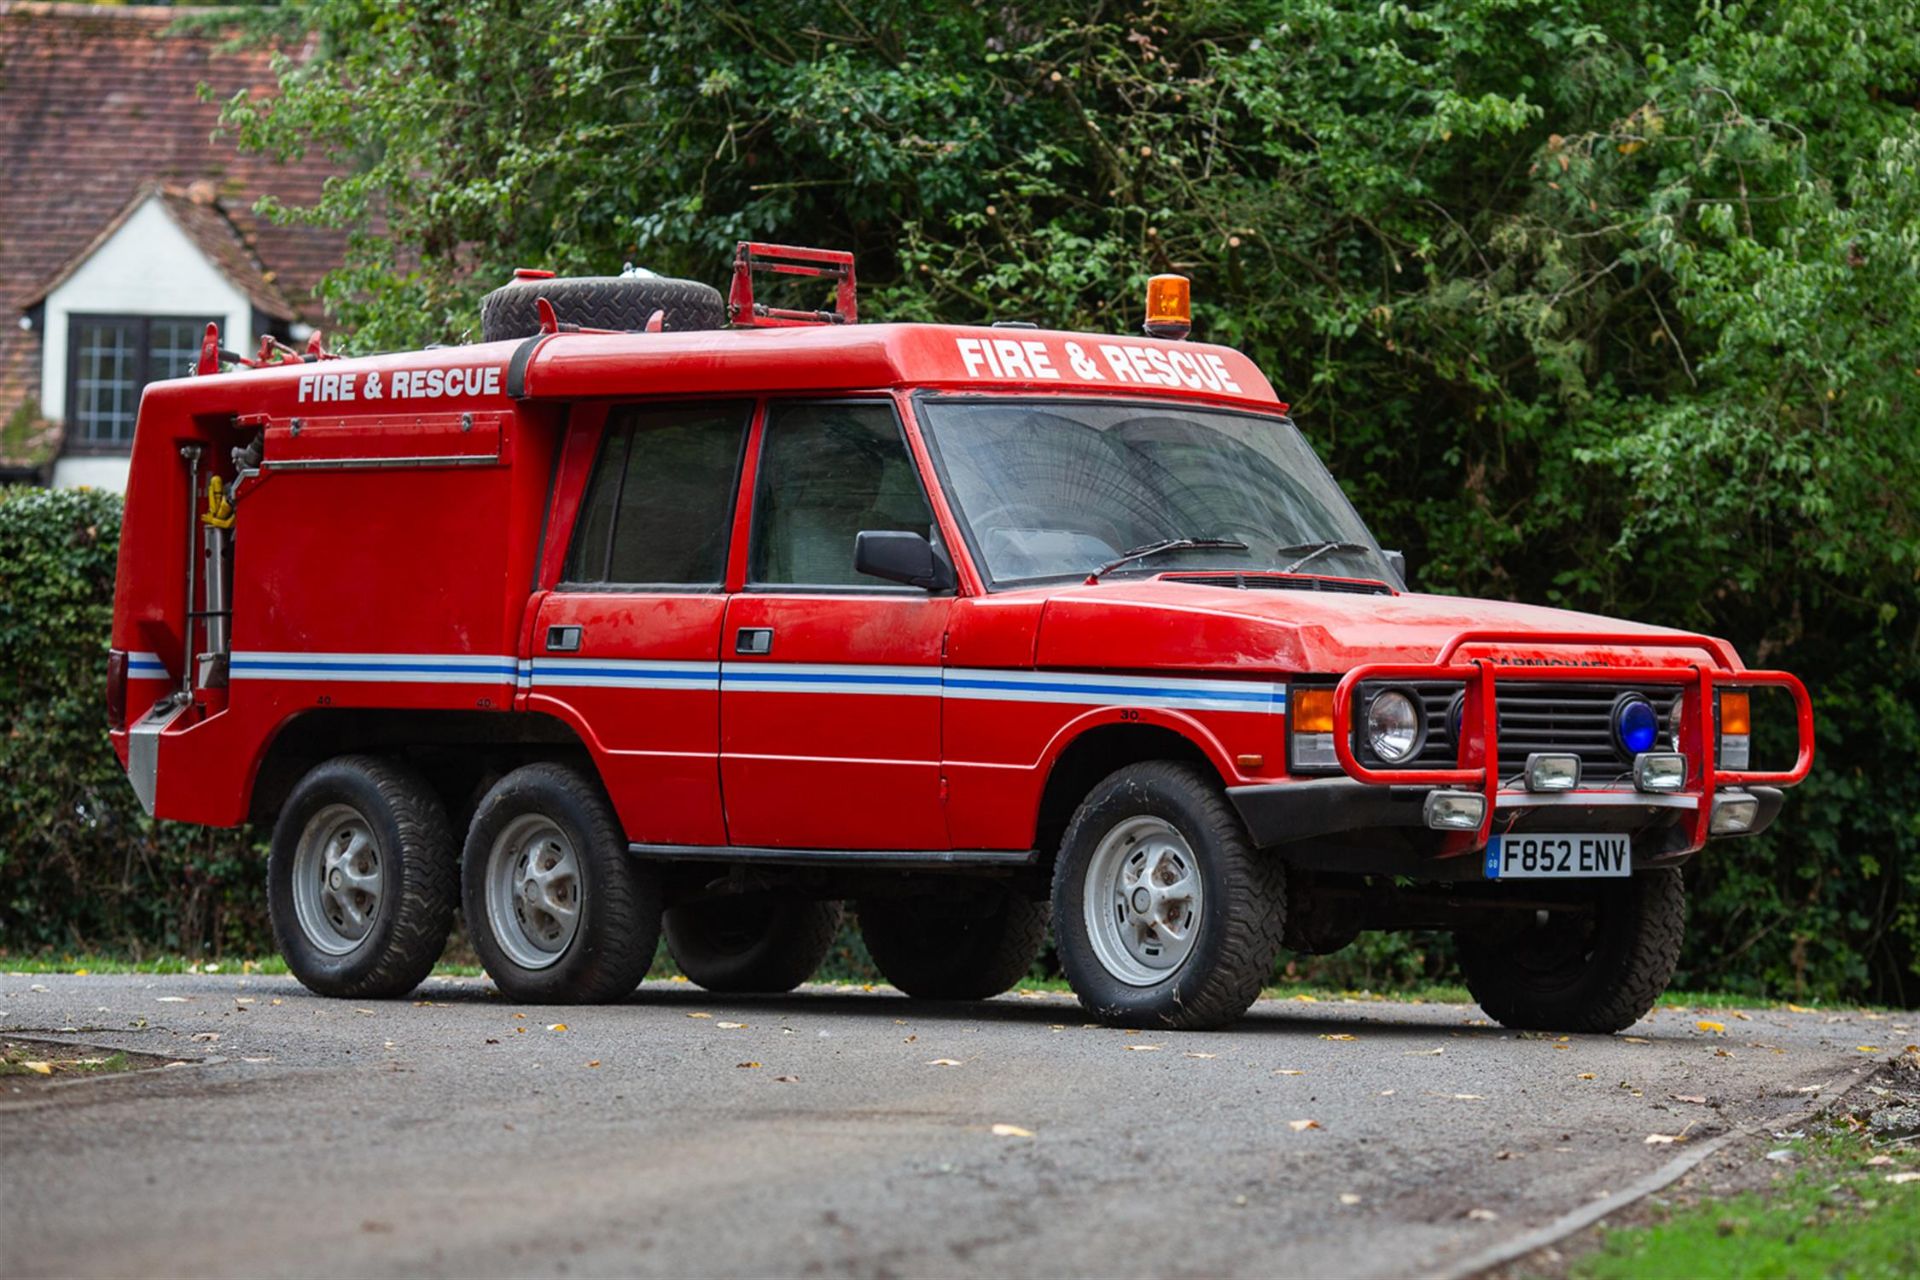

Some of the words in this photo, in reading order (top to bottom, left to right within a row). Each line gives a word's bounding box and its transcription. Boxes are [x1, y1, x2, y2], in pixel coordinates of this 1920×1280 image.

[955, 337, 1060, 380] FIRE
[1064, 340, 1105, 381] &
[1099, 344, 1243, 394] RESCUE
[298, 373, 357, 403] FIRE
[363, 371, 383, 400] &
[391, 367, 501, 399] RESCUE
[316, 695, 331, 705] 40
[1120, 709, 1139, 720] 30
[1504, 840, 1571, 872] F852
[1579, 840, 1625, 872] ENV
